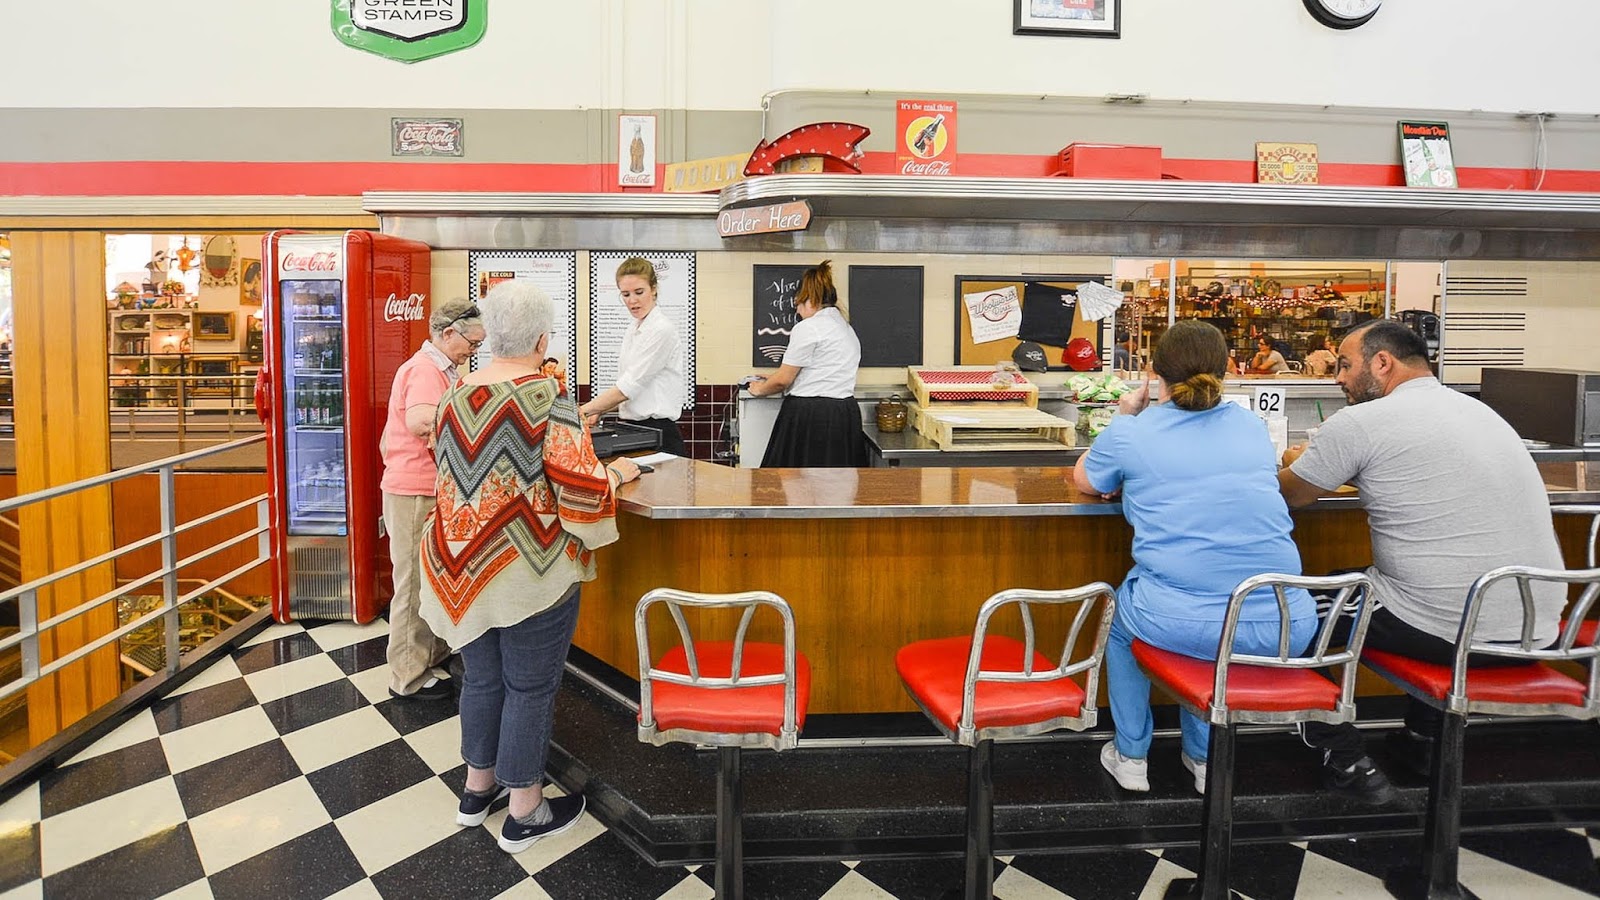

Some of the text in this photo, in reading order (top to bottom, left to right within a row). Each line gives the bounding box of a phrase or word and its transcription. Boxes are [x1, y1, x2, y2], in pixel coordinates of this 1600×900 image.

[364, 10, 453, 21] STAMPS
[901, 160, 952, 175] Coca-Cola
[720, 205, 803, 234] Order Here
[282, 251, 338, 272] Coca-Cola
[383, 292, 426, 322] Coca-Cola
[772, 294, 784, 311] of
[1259, 392, 1280, 411] 62
